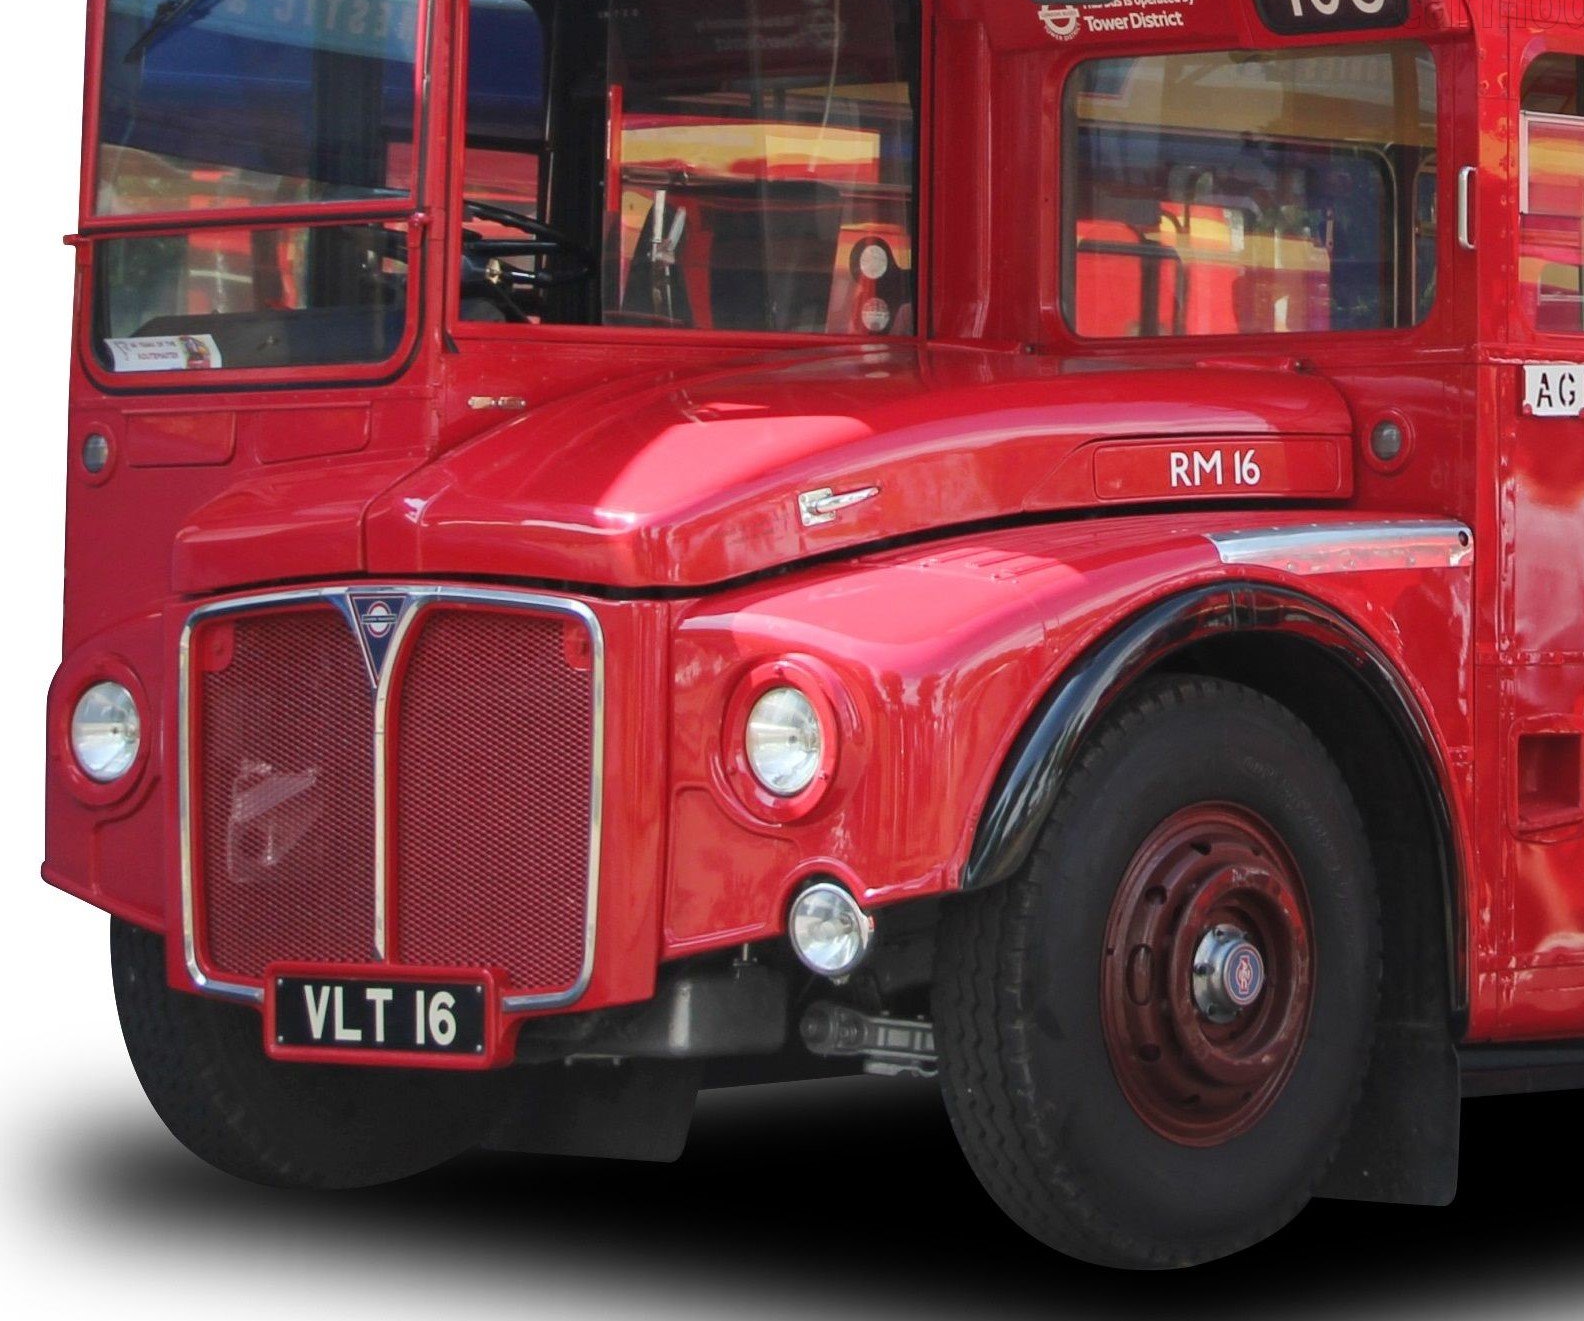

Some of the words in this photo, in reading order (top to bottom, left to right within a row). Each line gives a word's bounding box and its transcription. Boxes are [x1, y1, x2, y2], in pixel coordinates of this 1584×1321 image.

[1083, 15, 1129, 32] Tower
[1130, 10, 1184, 29] District
[1537, 372, 1576, 407] AG
[1170, 450, 1223, 487] RM
[1234, 449, 1261, 485] 16
[304, 985, 393, 1043] VLT
[416, 990, 457, 1046] 16
